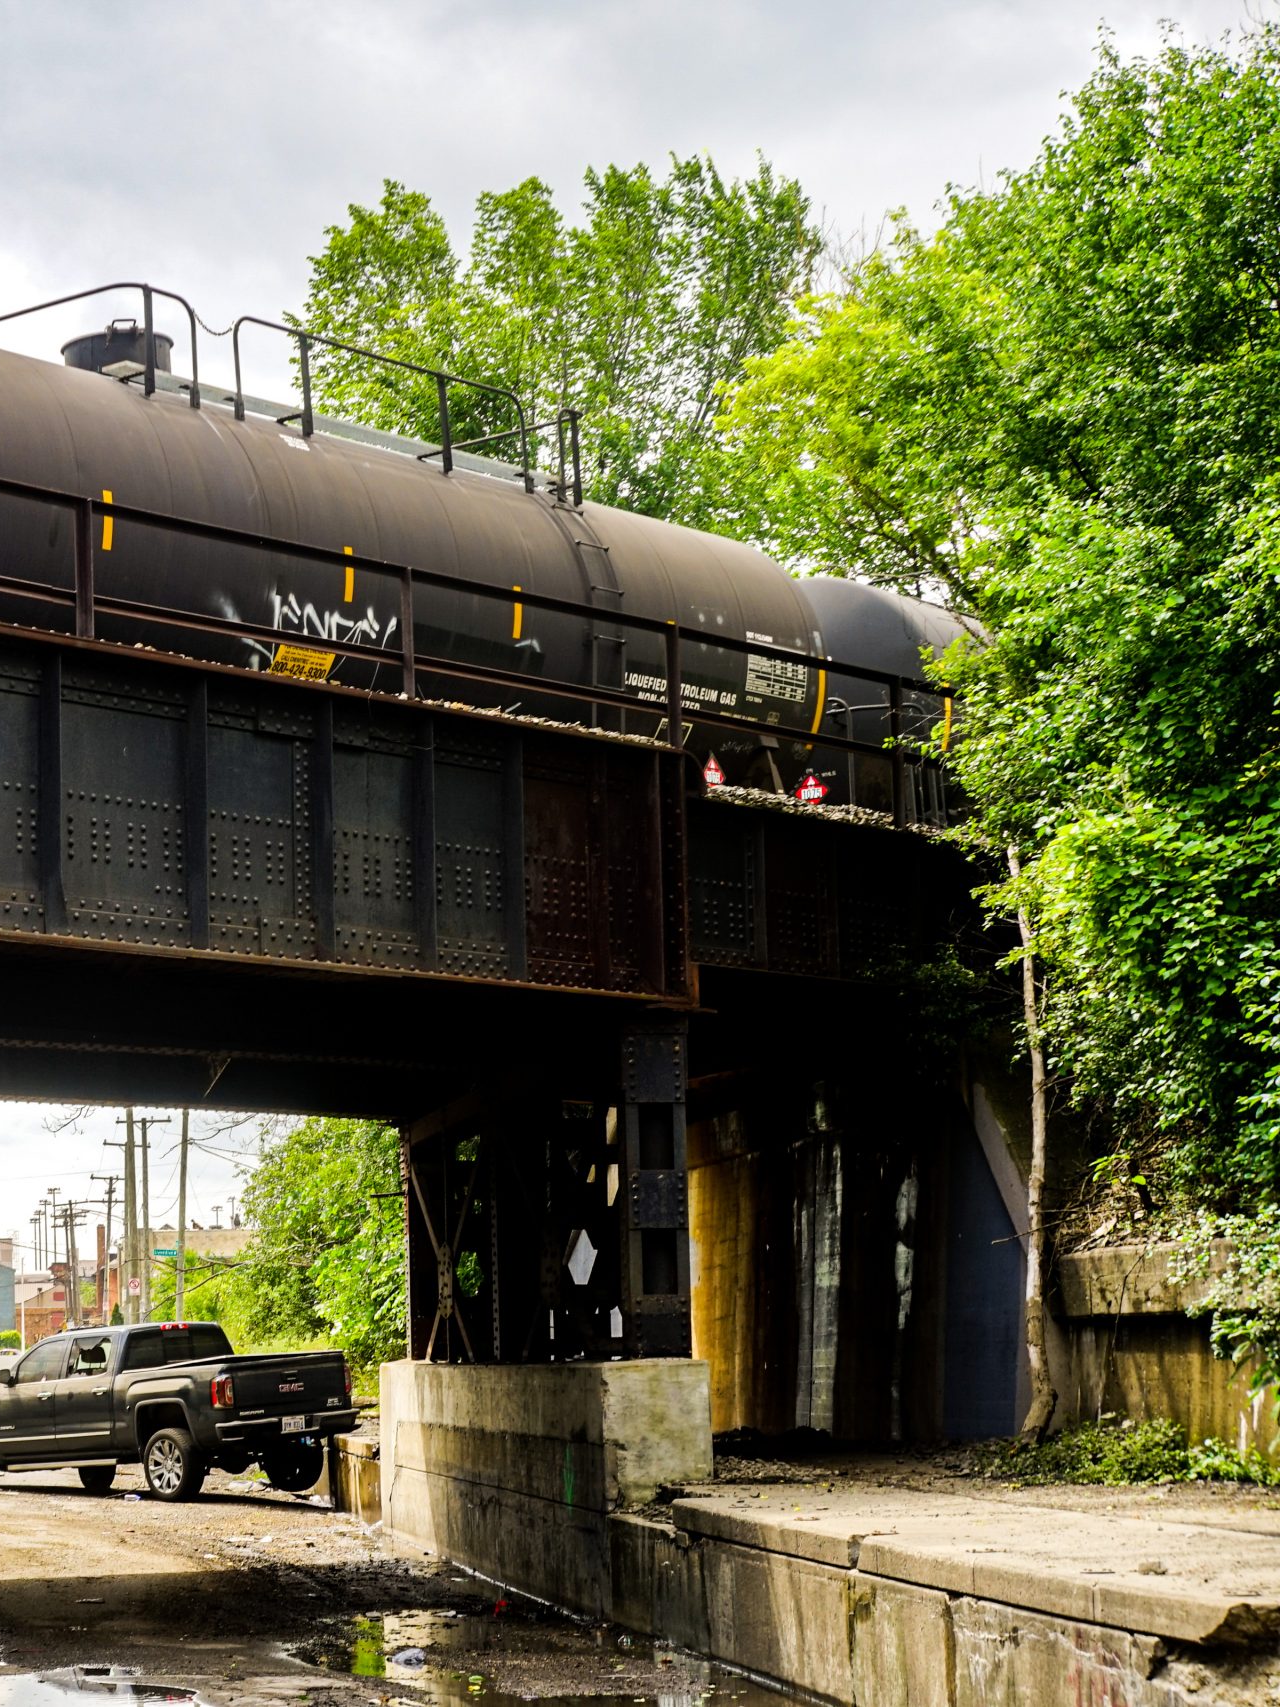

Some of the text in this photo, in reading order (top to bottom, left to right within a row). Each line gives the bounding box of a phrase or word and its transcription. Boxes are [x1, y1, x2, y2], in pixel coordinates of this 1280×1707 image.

[272, 660, 326, 679] 800-424-9300
[624, 672, 667, 692] LIQUEFIED
[680, 683, 718, 703] TROLEUM
[720, 692, 737, 706] GAS
[803, 788, 821, 799] 1075
[279, 1383, 304, 1392] GMC
